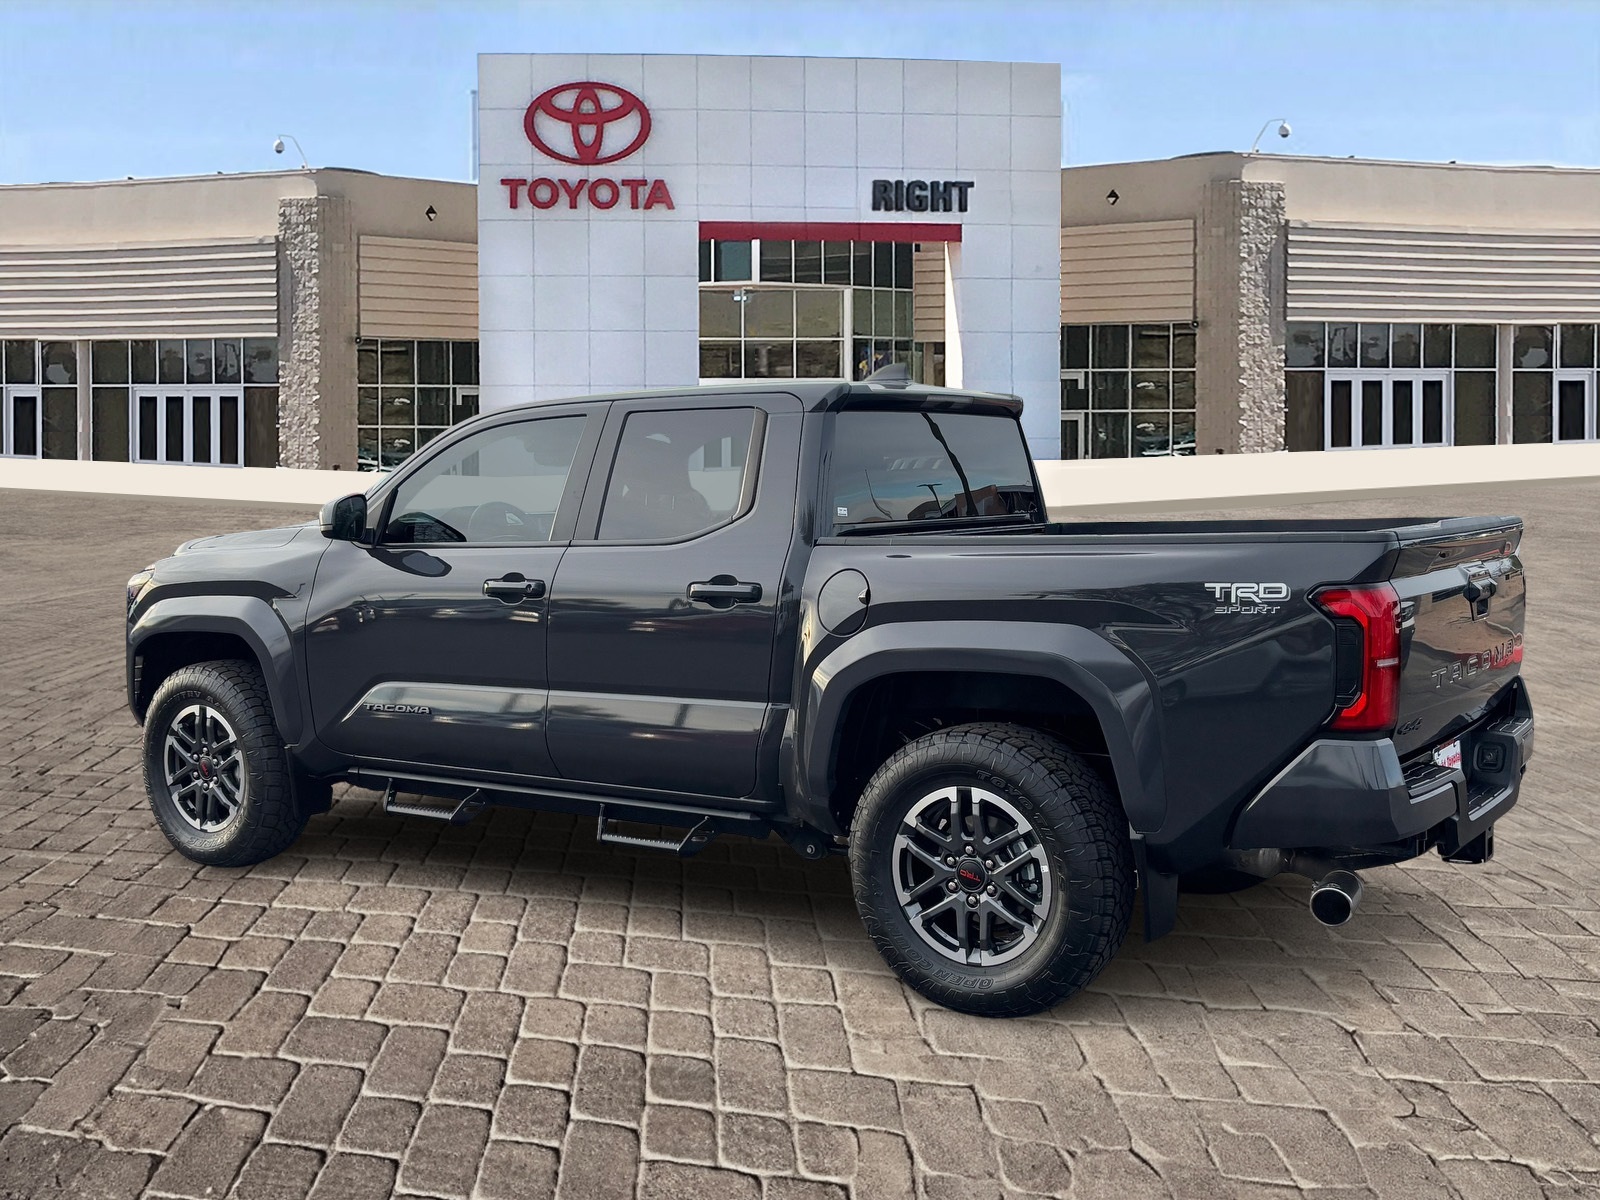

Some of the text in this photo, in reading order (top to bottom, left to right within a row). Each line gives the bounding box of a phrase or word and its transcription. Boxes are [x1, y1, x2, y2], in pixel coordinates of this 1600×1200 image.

[500, 177, 675, 210] TOYOTA
[871, 180, 975, 213] RIGHT
[1204, 582, 1291, 604] TRD
[1214, 605, 1281, 615] SPORT
[1431, 638, 1514, 689] TACOMA
[362, 702, 431, 714] TACOMA
[932, 967, 995, 990] OPEN
